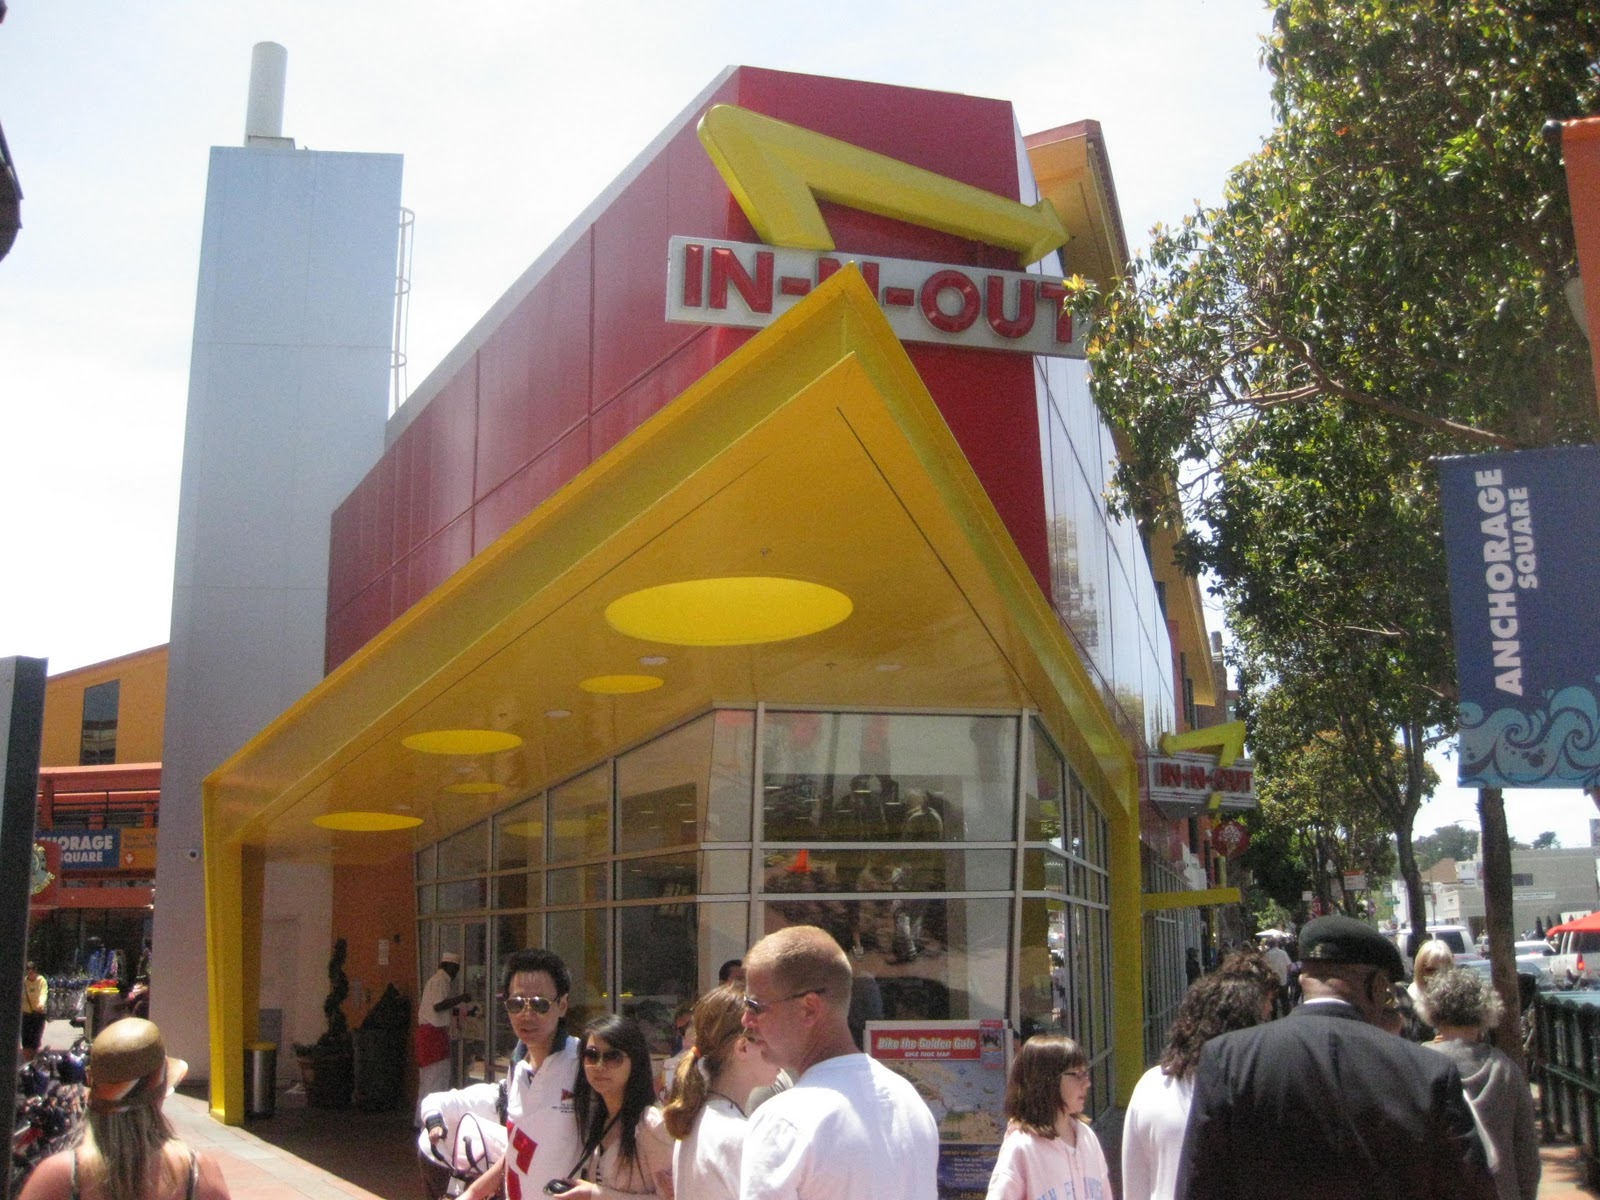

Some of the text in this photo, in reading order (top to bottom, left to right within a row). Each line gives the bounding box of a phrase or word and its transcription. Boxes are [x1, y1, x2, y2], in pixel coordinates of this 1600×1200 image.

[1507, 486, 1538, 589] SQUARE
[1475, 468, 1523, 696] ANCHORAGE
[60, 851, 103, 863] QUARE
[877, 1037, 977, 1049] Bike the Golden Gate
